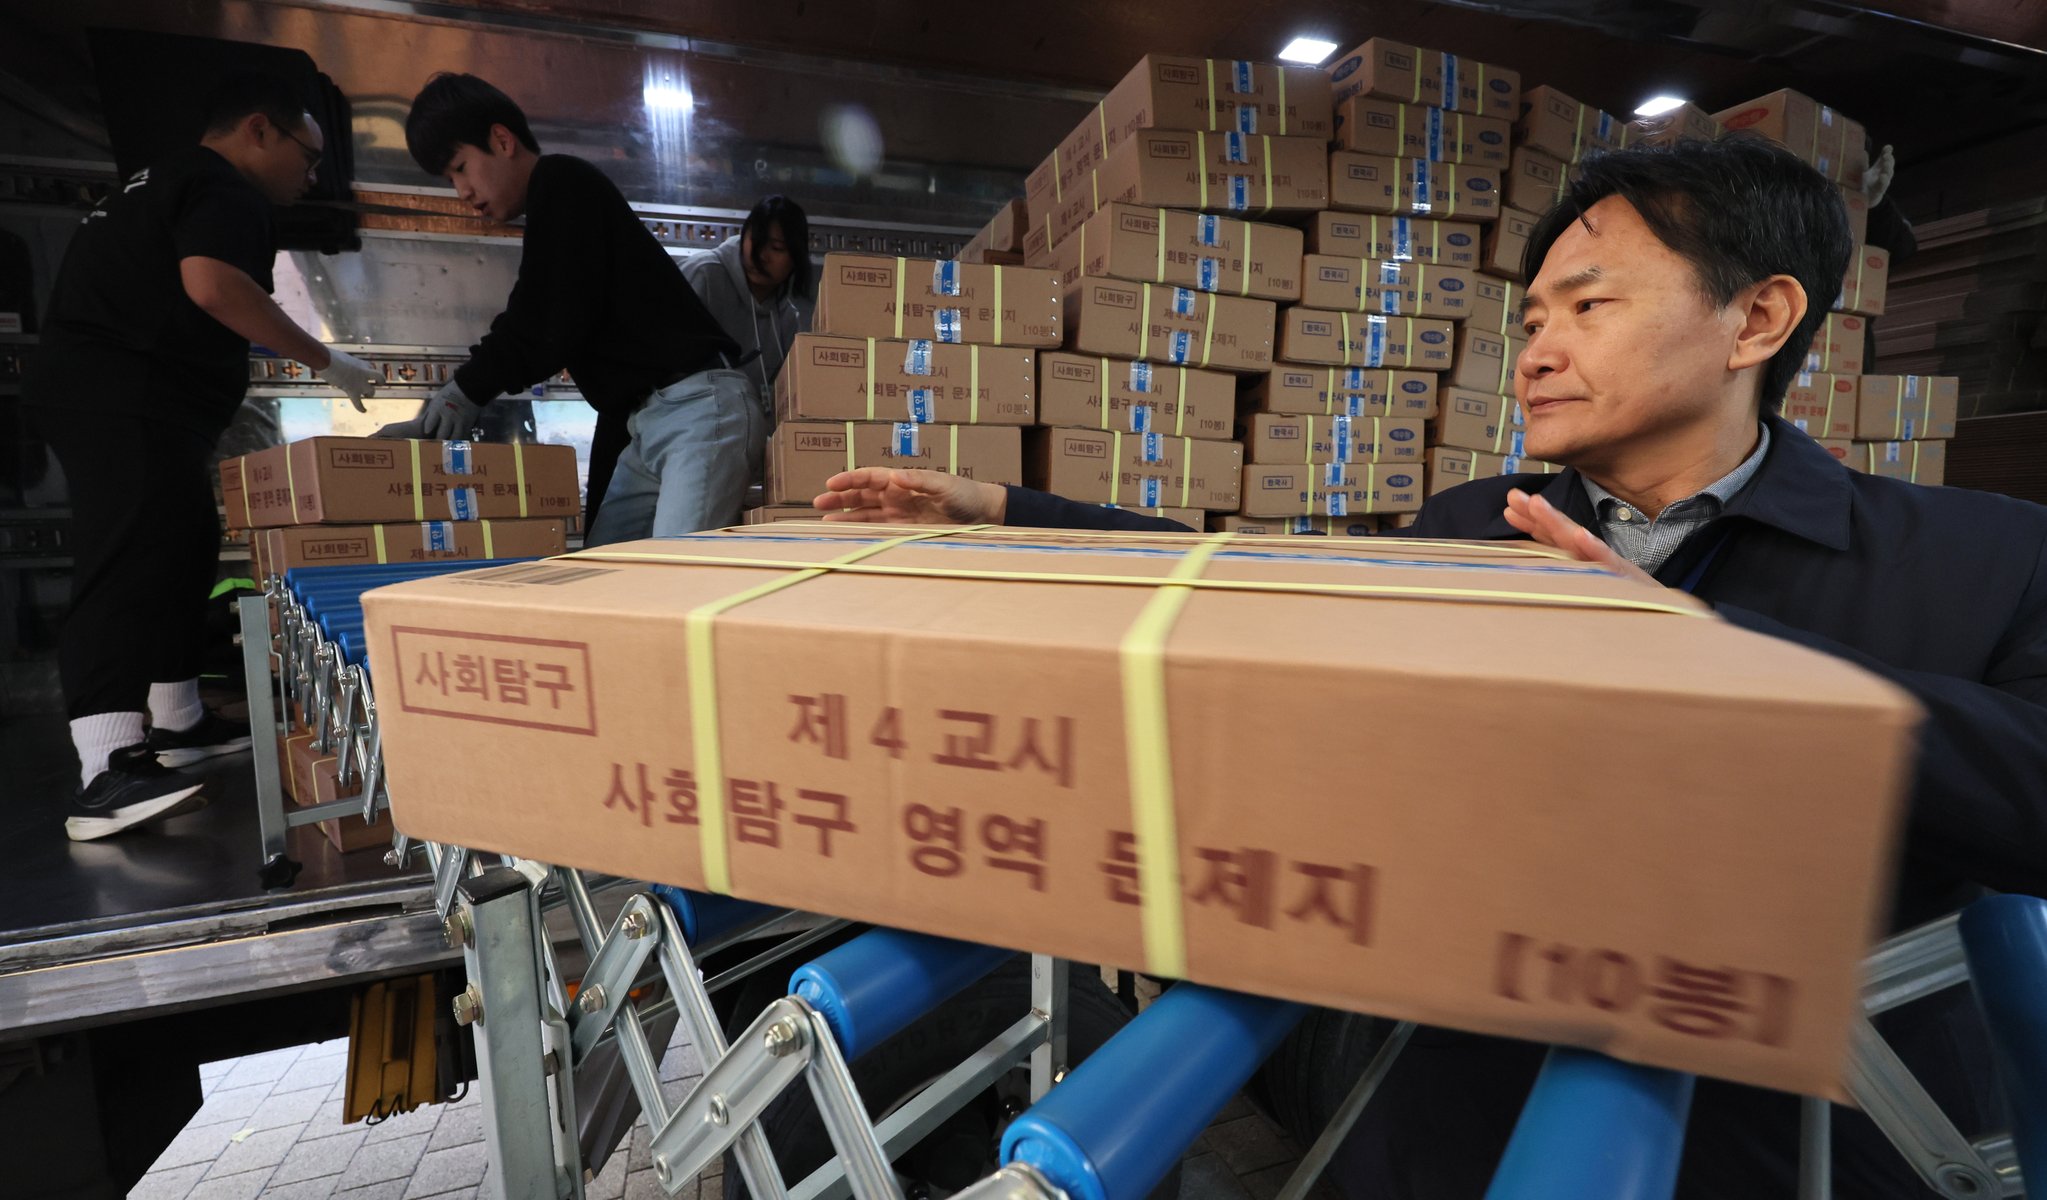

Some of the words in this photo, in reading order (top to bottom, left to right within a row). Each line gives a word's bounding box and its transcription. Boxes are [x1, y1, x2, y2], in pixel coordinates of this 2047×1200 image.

[1232, 260, 1263, 275] 문지
[846, 271, 888, 284] 사회탐구
[1098, 292, 1133, 305] 사회탐구
[979, 310, 1017, 323] 문지
[1128, 323, 1172, 338] 사탐구
[1306, 323, 1327, 333] 한국사
[819, 351, 860, 364] 사회탐구
[1056, 366, 1092, 379] 사회탐구
[1087, 395, 1131, 410] 사탐구
[1164, 403, 1195, 417] 문지
[1200, 419, 1226, 431] [10봉]
[1273, 428, 1294, 437] 한국사
[800, 436, 842, 448] 사회탐구
[1068, 441, 1102, 454] 사회탐구
[339, 453, 388, 465] 사회탐구
[1267, 479, 1288, 487] 한국사
[540, 497, 570, 507] [10봉]
[308, 543, 362, 555] 사회탐구
[416, 651, 576, 710] 사회탐구
[787, 693, 850, 761] 제
[871, 706, 907, 760] 4
[931, 708, 1078, 789] 교시
[603, 762, 858, 859] 사회탐구
[902, 802, 1049, 894] 영역
[1492, 931, 1797, 1049] [10봉]
